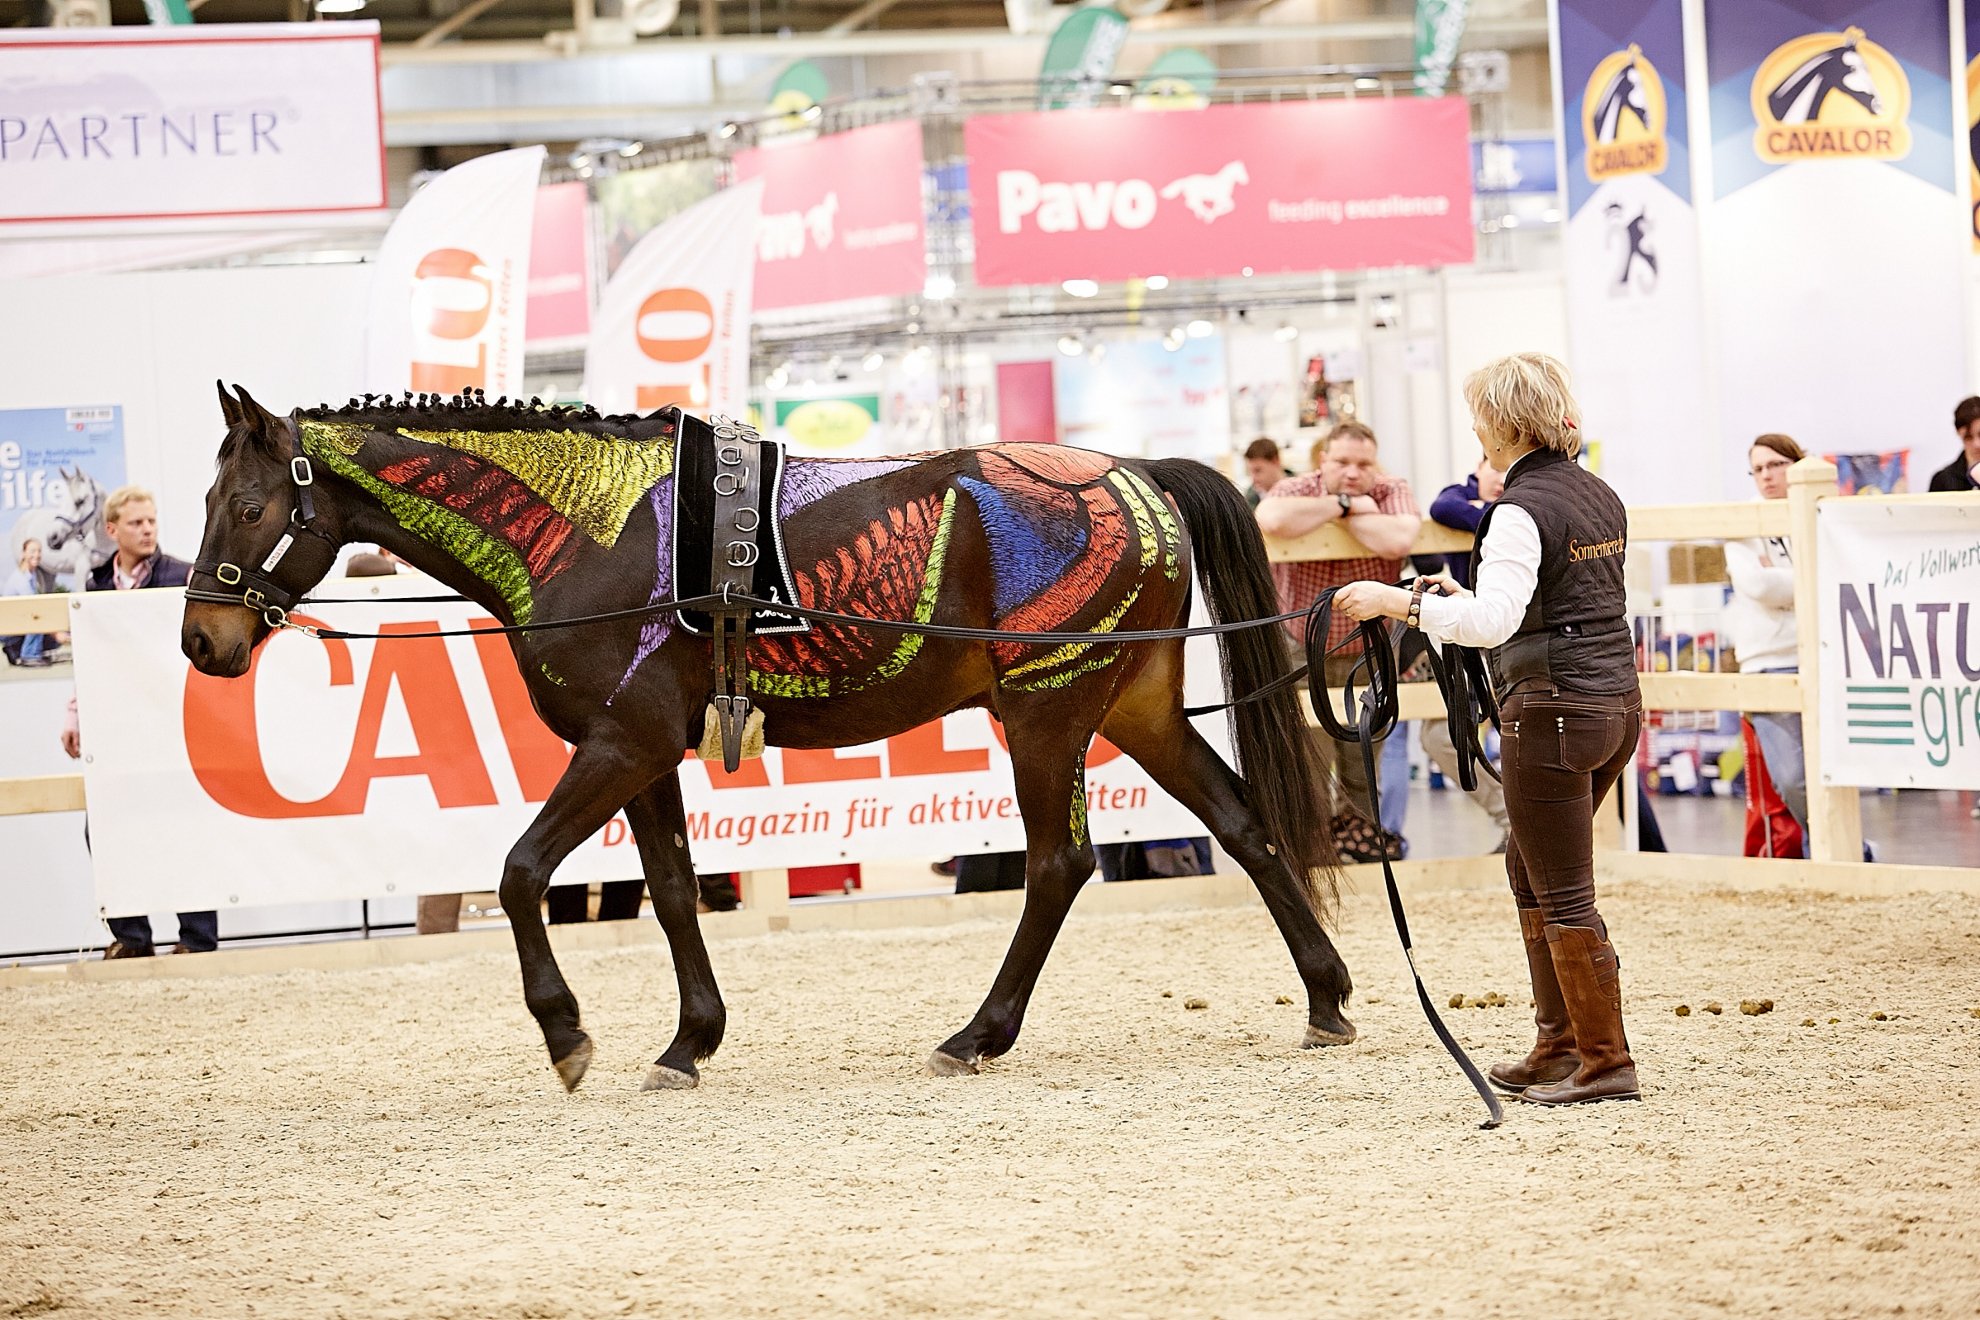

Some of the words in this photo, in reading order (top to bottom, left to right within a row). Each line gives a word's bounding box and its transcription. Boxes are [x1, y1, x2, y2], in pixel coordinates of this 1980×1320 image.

[0, 112, 281, 160] PARTNER
[1767, 130, 1892, 154] CAVALOR
[997, 169, 1157, 234] Pavo
[1883, 560, 1912, 588] Das
[1921, 686, 1980, 767] gr
[686, 803, 829, 846] Magazin
[843, 798, 893, 838] für
[908, 790, 1022, 826] aktive
